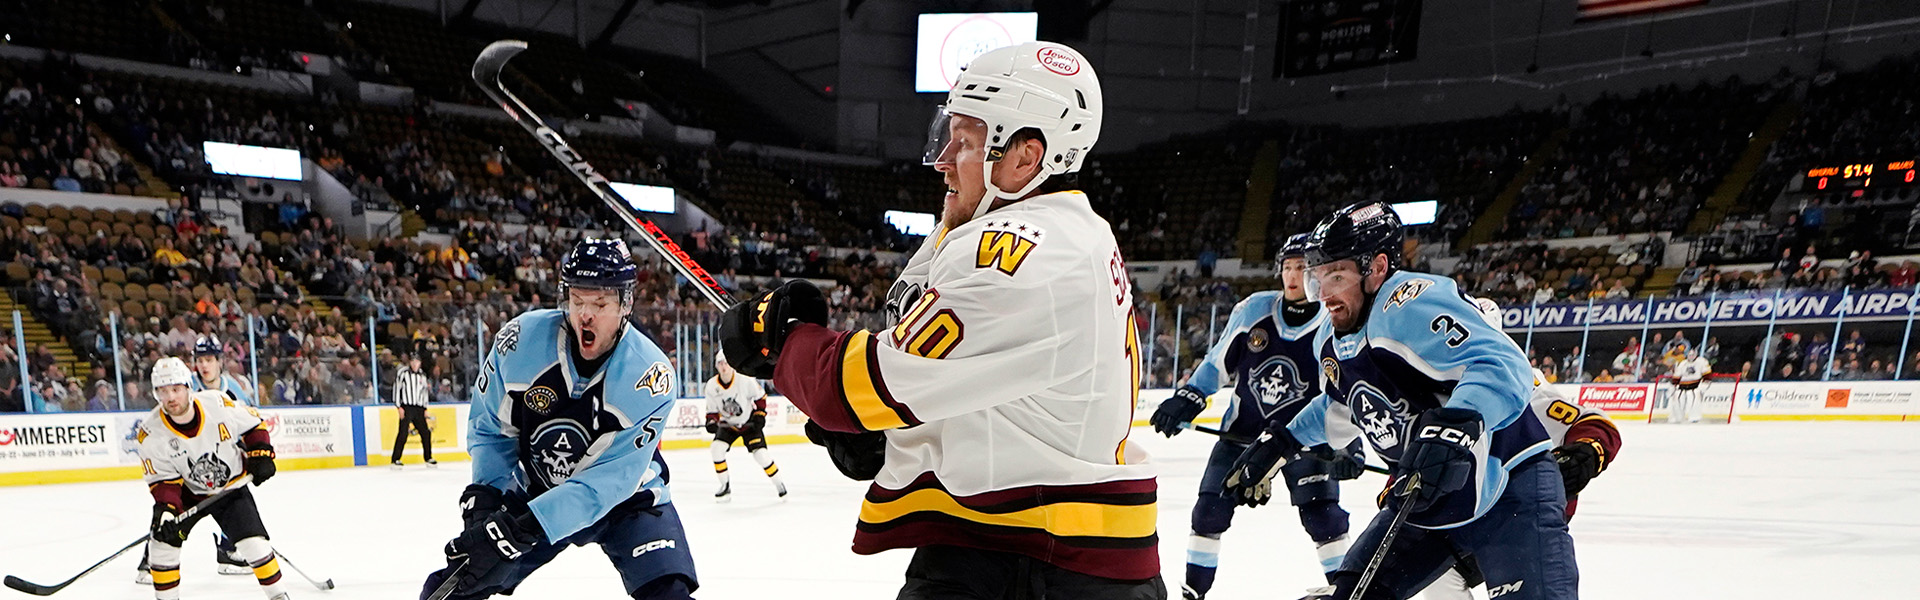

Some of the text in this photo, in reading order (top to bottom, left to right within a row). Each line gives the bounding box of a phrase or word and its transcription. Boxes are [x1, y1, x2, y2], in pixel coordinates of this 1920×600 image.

[1043, 50, 1075, 64] Jewel
[536, 126, 607, 198] CCM
[1818, 177, 1828, 190] 0
[1904, 169, 1915, 182] 0
[975, 230, 1037, 277] W
[1572, 301, 1646, 325] TEAM.
[1654, 294, 1829, 322] HOMETOWN
[892, 287, 965, 360] 10
[1430, 313, 1471, 348] 3
[1361, 394, 1373, 412] A
[1581, 388, 1645, 400] KWIK TRIP
[218, 421, 232, 442] A
[554, 432, 572, 449] A
[1419, 426, 1476, 450] CCM
[485, 520, 523, 560] CC
[632, 538, 676, 558] CCM
[1488, 579, 1524, 600] CM
